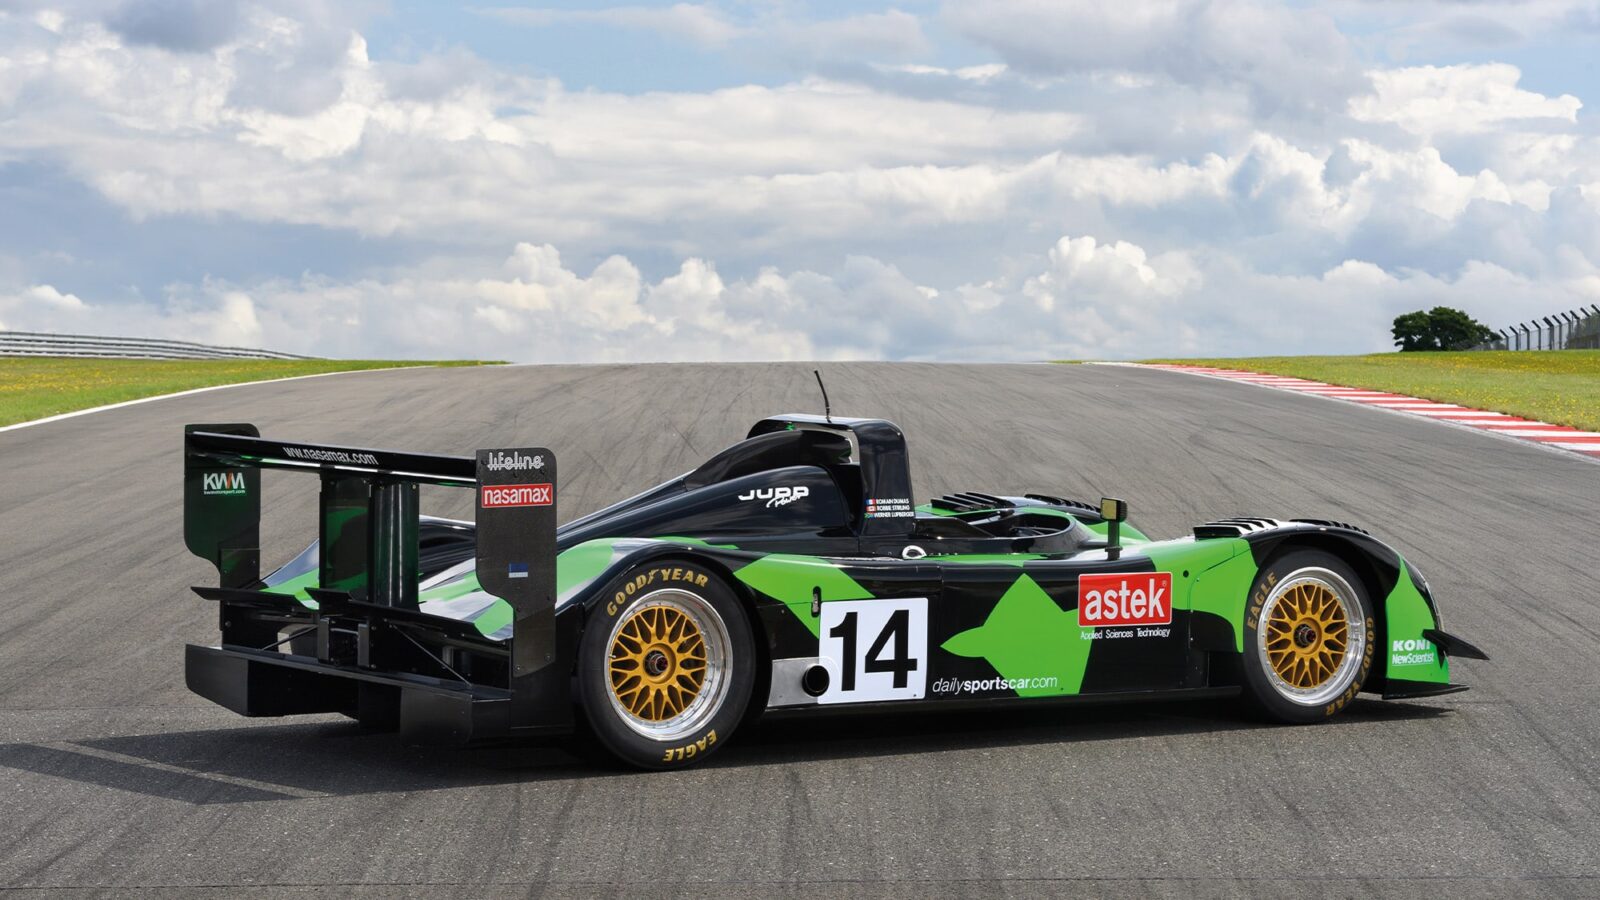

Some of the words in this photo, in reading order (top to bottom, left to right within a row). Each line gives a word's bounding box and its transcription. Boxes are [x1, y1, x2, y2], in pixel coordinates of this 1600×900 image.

[487, 452, 544, 471] lifeline
[204, 471, 245, 490] KWM
[484, 487, 550, 504] nasamax
[606, 568, 709, 617] GOODYEAR
[1085, 578, 1165, 621] astek
[1247, 572, 1277, 630] EAGLE
[1080, 629, 1103, 640] Applied
[1105, 628, 1133, 639] Sciences
[1136, 627, 1171, 638] Technology
[829, 609, 917, 692] 14
[1392, 640, 1430, 651] KONI
[931, 676, 1058, 695] dailysportscar.com
[662, 729, 717, 762] EAGLE
